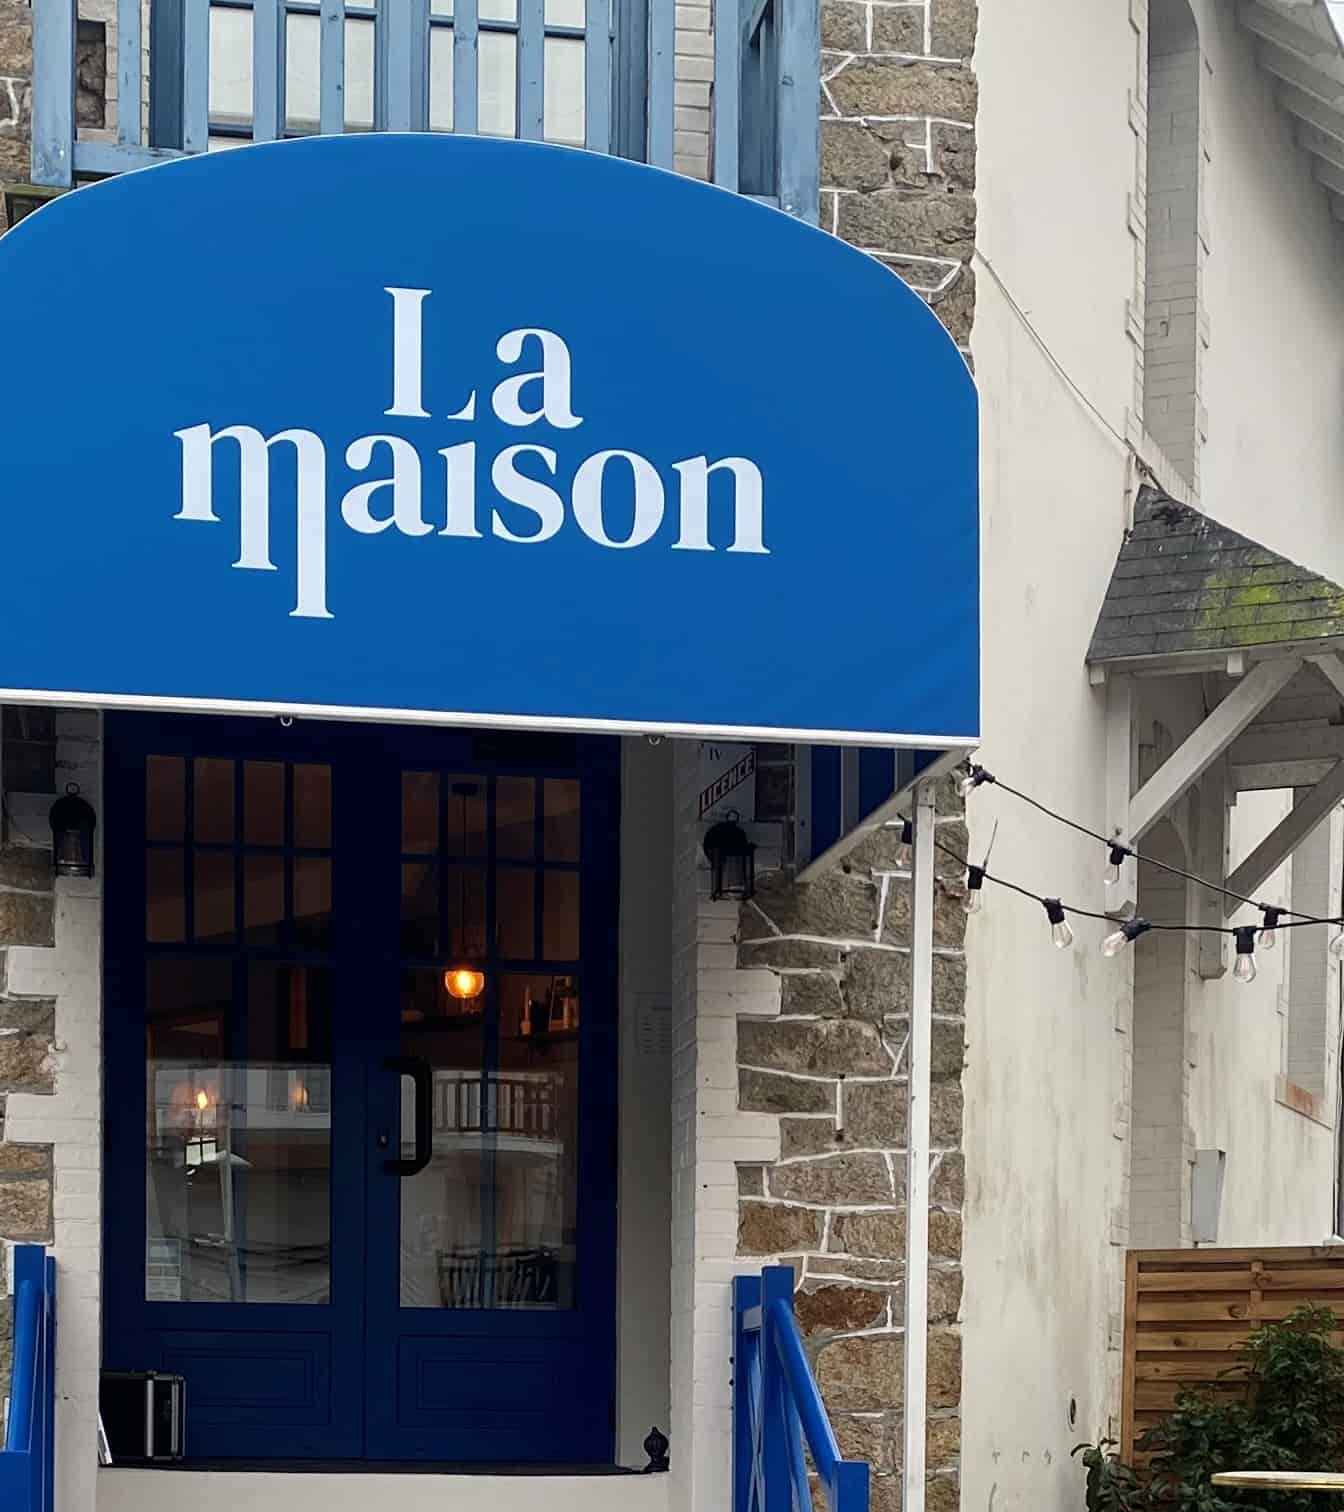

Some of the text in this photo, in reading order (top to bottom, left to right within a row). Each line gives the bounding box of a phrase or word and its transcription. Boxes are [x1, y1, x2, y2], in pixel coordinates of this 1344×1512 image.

[383, 287, 583, 430] La
[173, 422, 770, 620] maison
[701, 755, 753, 811] LICENCE
